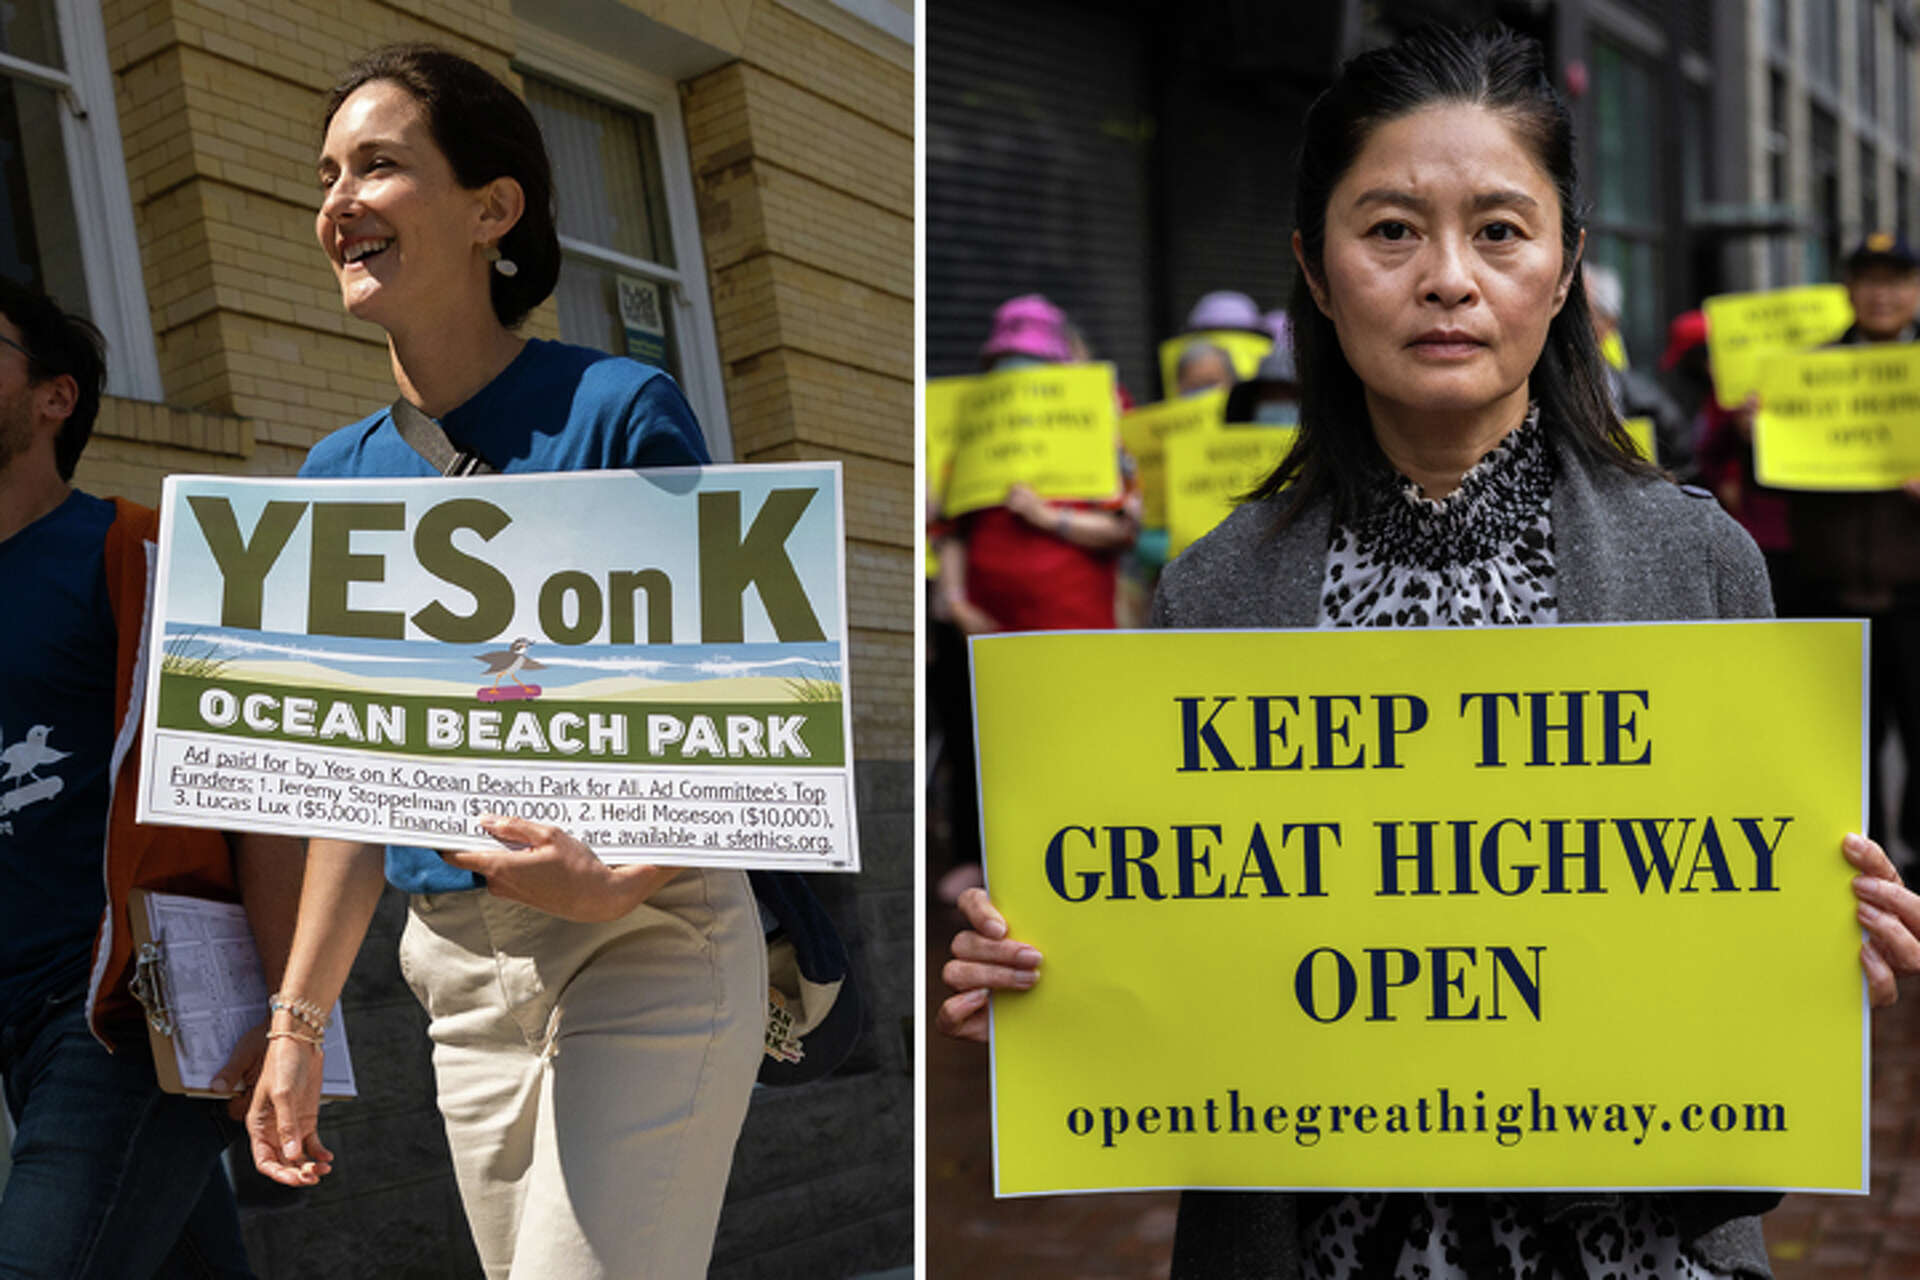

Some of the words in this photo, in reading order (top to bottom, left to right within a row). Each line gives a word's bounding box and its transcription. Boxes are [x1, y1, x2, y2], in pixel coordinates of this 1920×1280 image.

[187, 494, 515, 643] YES
[538, 568, 673, 645] on
[698, 487, 828, 644] K
[199, 688, 407, 746] OCEAN
[427, 708, 629, 756] BEACH
[647, 713, 812, 759] PARK
[1174, 695, 1428, 771] KEEP
[1461, 691, 1651, 767] THE
[170, 765, 254, 794] Funders:
[260, 777, 273, 793] 1.
[279, 778, 342, 801] Jeremy
[349, 786, 457, 814] Stoppelman
[579, 802, 596, 821] 2.
[601, 802, 646, 822] Heidi
[652, 804, 734, 825] Moseson
[184, 746, 210, 763] Ad
[216, 751, 256, 770] paid
[263, 753, 291, 771] for
[296, 757, 318, 778] by
[324, 760, 355, 779] Yes
[360, 767, 385, 783] on
[413, 769, 470, 791] Ocean
[477, 773, 534, 794] Beach
[540, 776, 581, 796] Park
[587, 778, 612, 796] for
[650, 779, 674, 797] Ad
[680, 781, 788, 801] Committee's
[794, 781, 827, 805] Top
[175, 788, 191, 807] 3.
[196, 791, 251, 811] Lucas
[258, 796, 290, 816] Lux
[389, 810, 467, 835] Financial
[580, 828, 612, 845] are
[618, 826, 697, 846] available
[703, 831, 718, 846] at
[1045, 823, 1341, 902] GREAT
[1374, 817, 1793, 896] HIGHWAY
[1295, 947, 1546, 1023] OPEN
[1068, 1089, 1786, 1147] openthegreathighway.com
